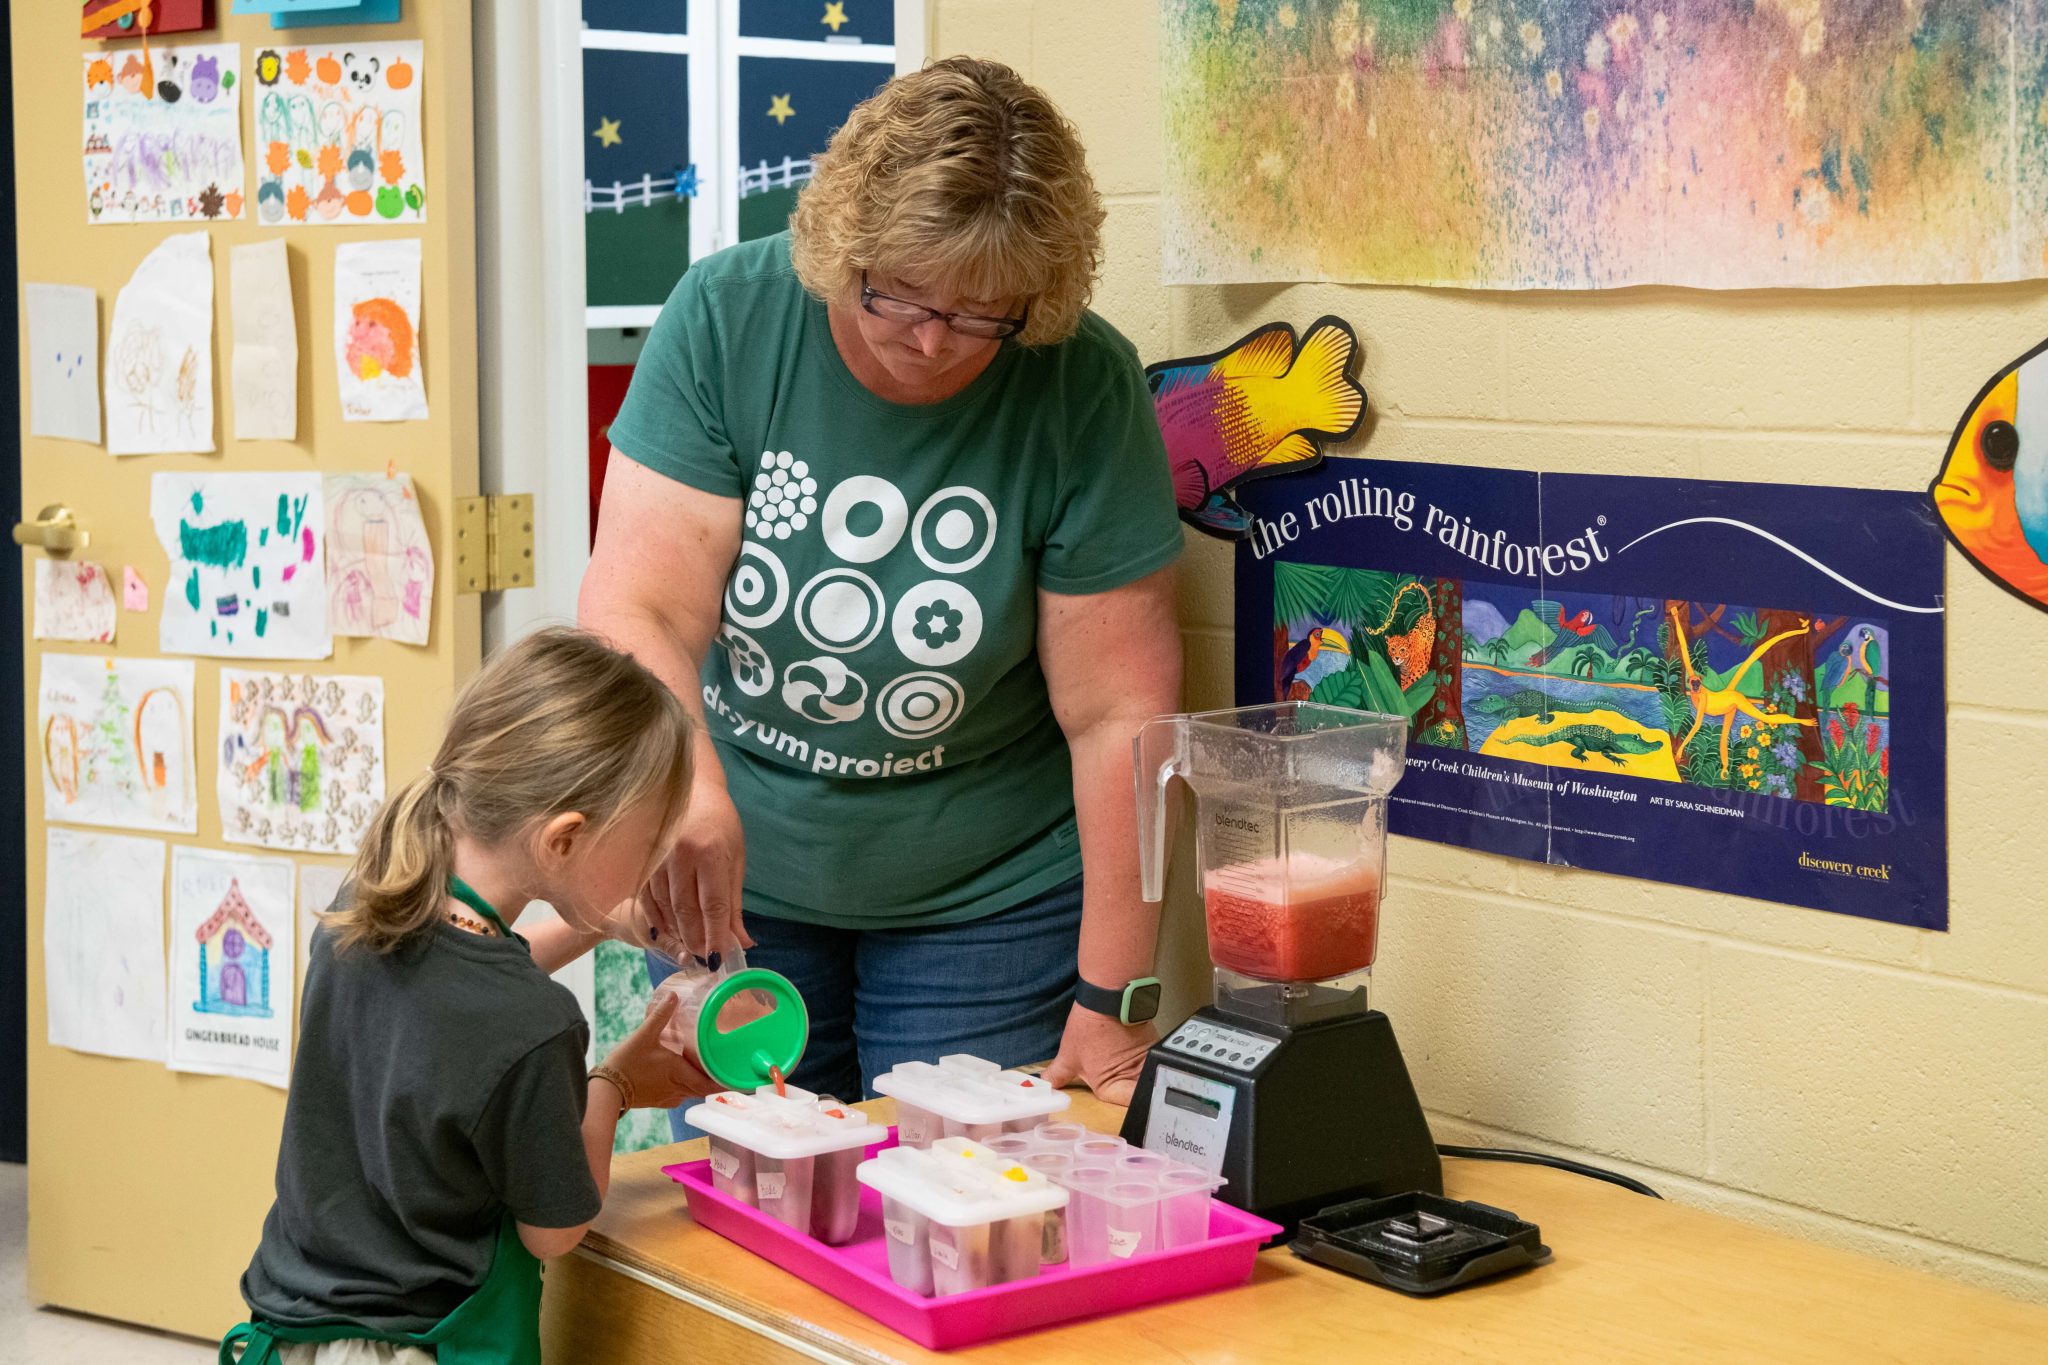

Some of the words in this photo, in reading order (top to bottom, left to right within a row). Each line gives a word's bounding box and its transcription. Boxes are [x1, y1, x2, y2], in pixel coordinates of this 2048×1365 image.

[1250, 511, 1300, 560] the
[1305, 478, 1417, 532] rolling
[811, 744, 946, 779] project
[1431, 758, 1460, 775] Creek
[1461, 763, 1511, 784] Children's
[1511, 772, 1554, 792] Museum
[1555, 780, 1571, 797] of
[1571, 781, 1639, 804] Washington
[1649, 796, 1664, 806] ART
[1664, 798, 1675, 808] BY
[1675, 800, 1695, 811] SARA
[1694, 803, 1745, 818] SCHNEIDMAN
[1215, 812, 1261, 834] blendtec
[1798, 851, 1854, 876] discovery
[252, 1034, 280, 1052] HOUSE
